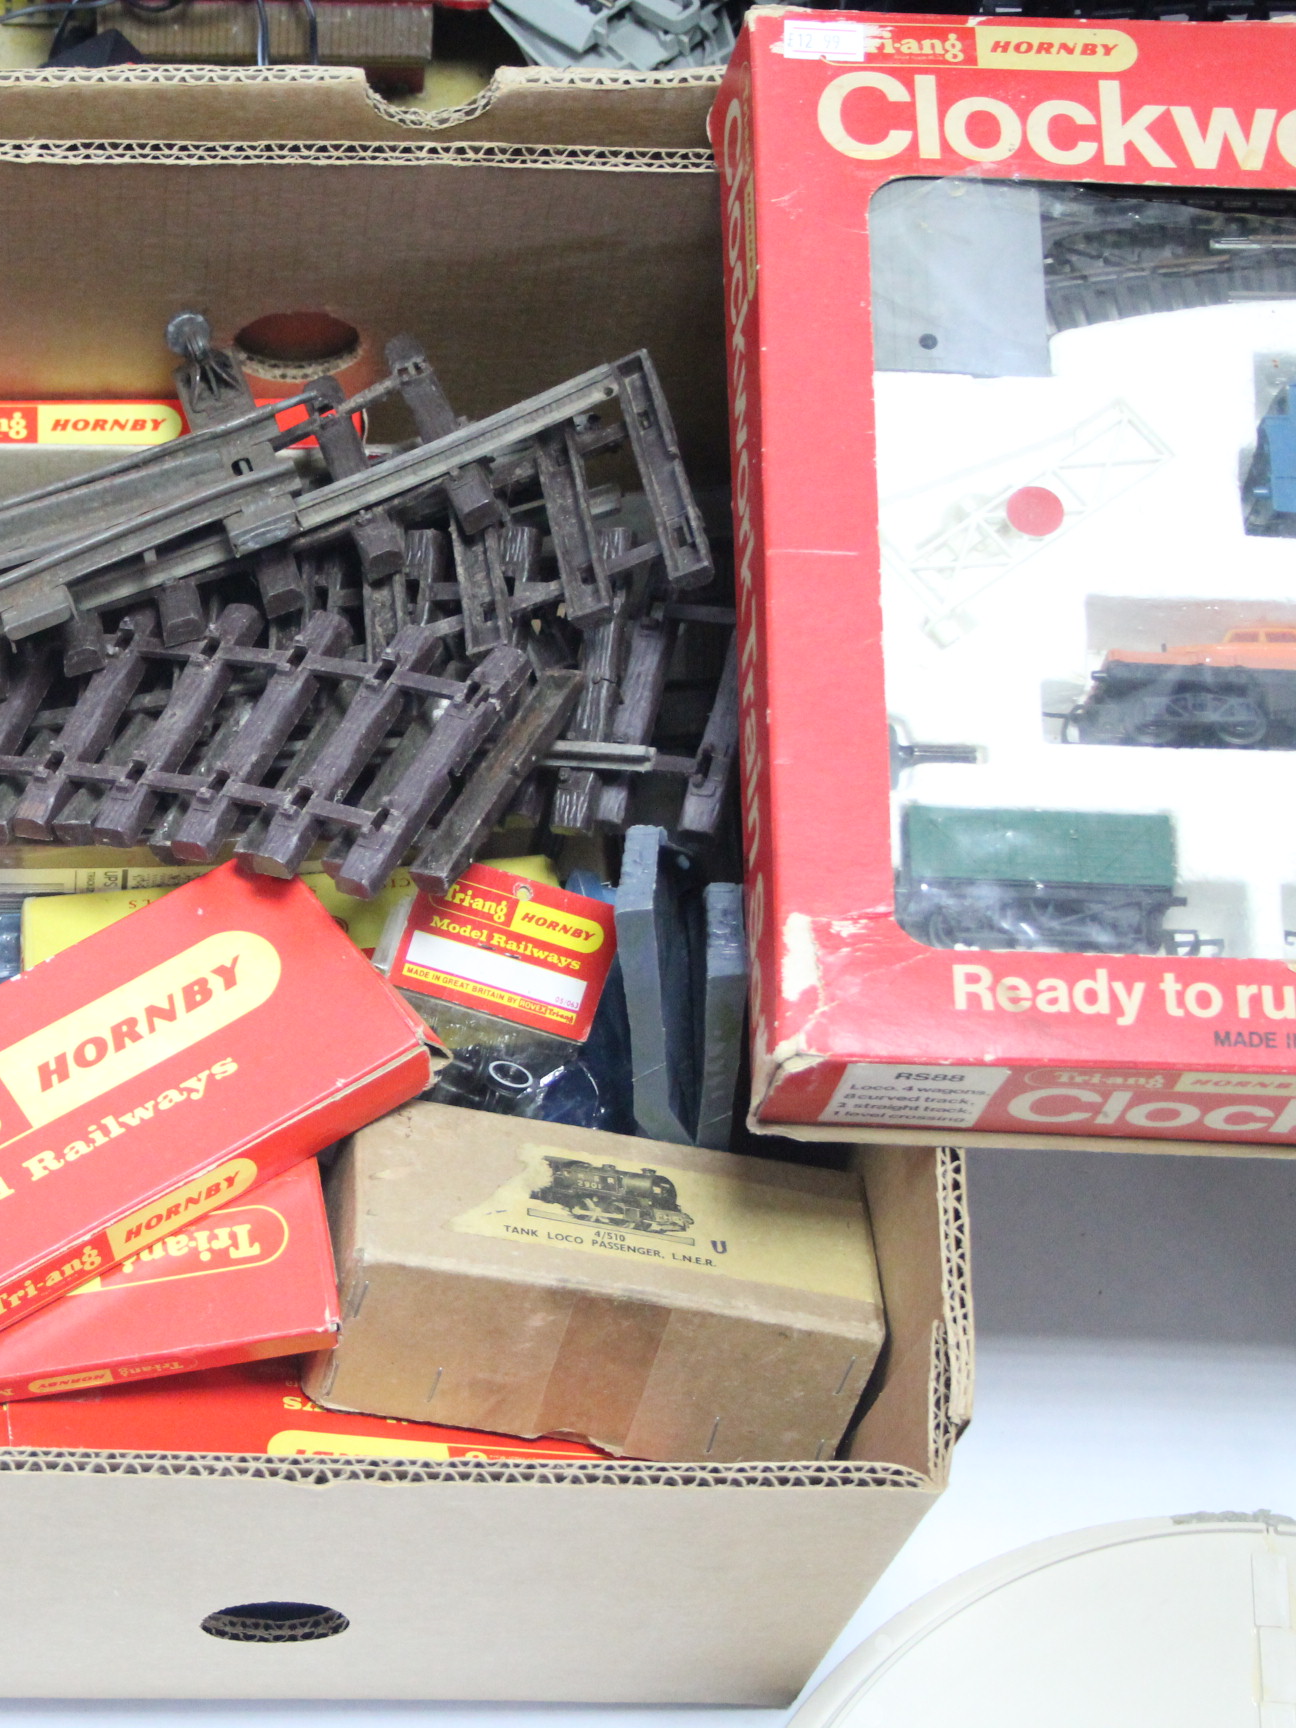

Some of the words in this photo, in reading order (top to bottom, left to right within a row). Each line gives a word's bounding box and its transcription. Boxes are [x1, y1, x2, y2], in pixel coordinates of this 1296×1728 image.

[864, 32, 964, 62] ri-ang
[990, 40, 1119, 57] HORNBY
[817, 71, 1296, 170] Clockw
[723, 98, 755, 621] Clockwork
[50, 418, 167, 432] HORNBY
[742, 593, 762, 866] Train
[103, 870, 119, 889] UPS
[444, 884, 508, 922] Tri-ang
[520, 912, 597, 942] HORNBY
[430, 916, 488, 941] Model
[491, 933, 582, 970] Railways
[748, 872, 765, 1045] Se
[406, 967, 429, 979] MADE
[431, 973, 441, 981] IN
[442, 975, 470, 990] GREAT
[471, 984, 505, 1000] BRITAIN
[506, 994, 518, 1004] BY
[519, 999, 547, 1014] ROVEX
[952, 964, 1144, 1025] Ready
[1160, 973, 1223, 1018] to
[1236, 985, 1296, 1019] ru
[36, 956, 241, 1092] HORNBY
[1214, 1030, 1278, 1048] MADE
[1286, 1033, 1296, 1048] I
[894, 1072, 966, 1082] RS88
[1054, 1070, 1165, 1089] Tri-ang
[1189, 1079, 1296, 1090] HORNB
[21, 1056, 239, 1181] Railways
[124, 1169, 241, 1244] HORNBY
[505, 1225, 538, 1237] TANK
[547, 1232, 584, 1244] LOCO
[594, 1231, 626, 1242] 4/510
[36, 1373, 106, 1391] HORNBY
